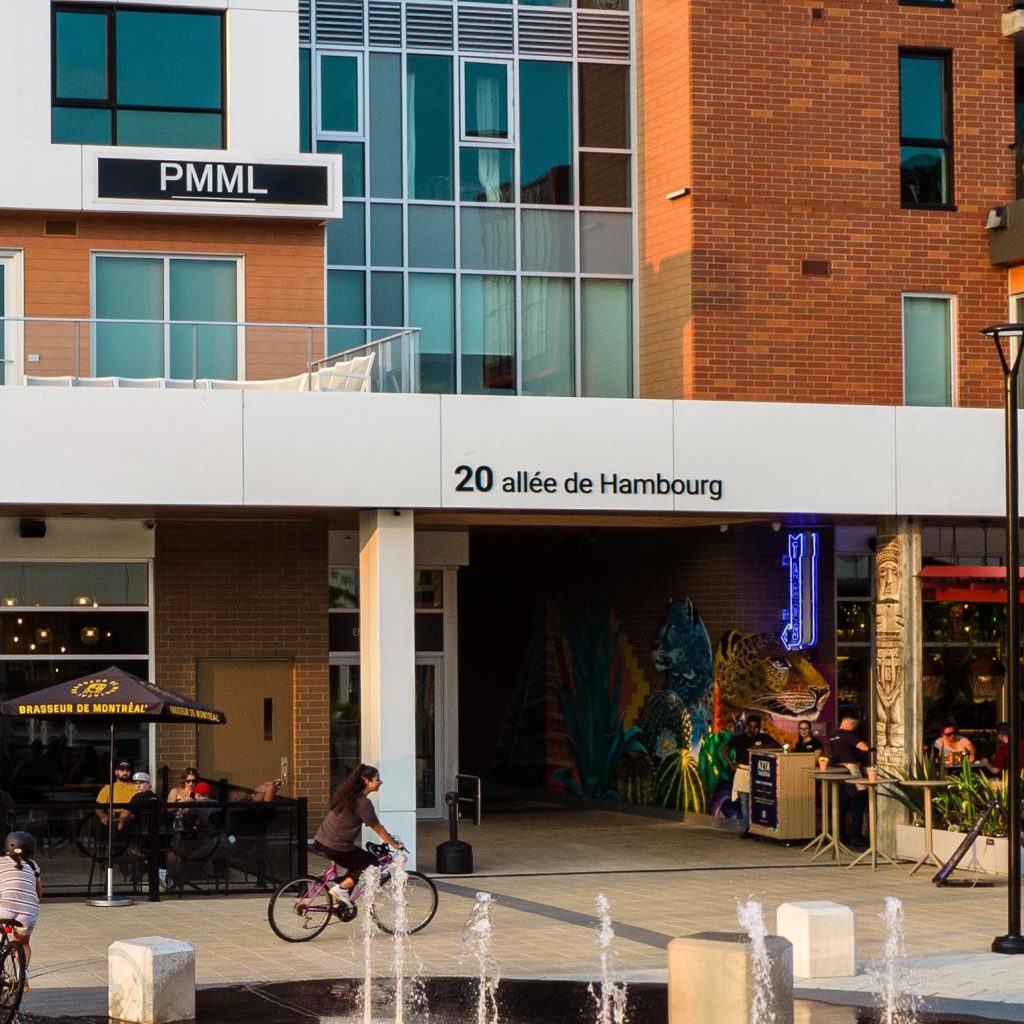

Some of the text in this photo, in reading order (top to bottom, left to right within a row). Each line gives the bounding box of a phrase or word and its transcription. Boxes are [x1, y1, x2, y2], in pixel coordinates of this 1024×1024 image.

[160, 162, 268, 194] PMML
[454, 465, 723, 500] 20 allée de Hambourg
[19, 702, 146, 714] BRASSEUR DE MONTRÉAL
